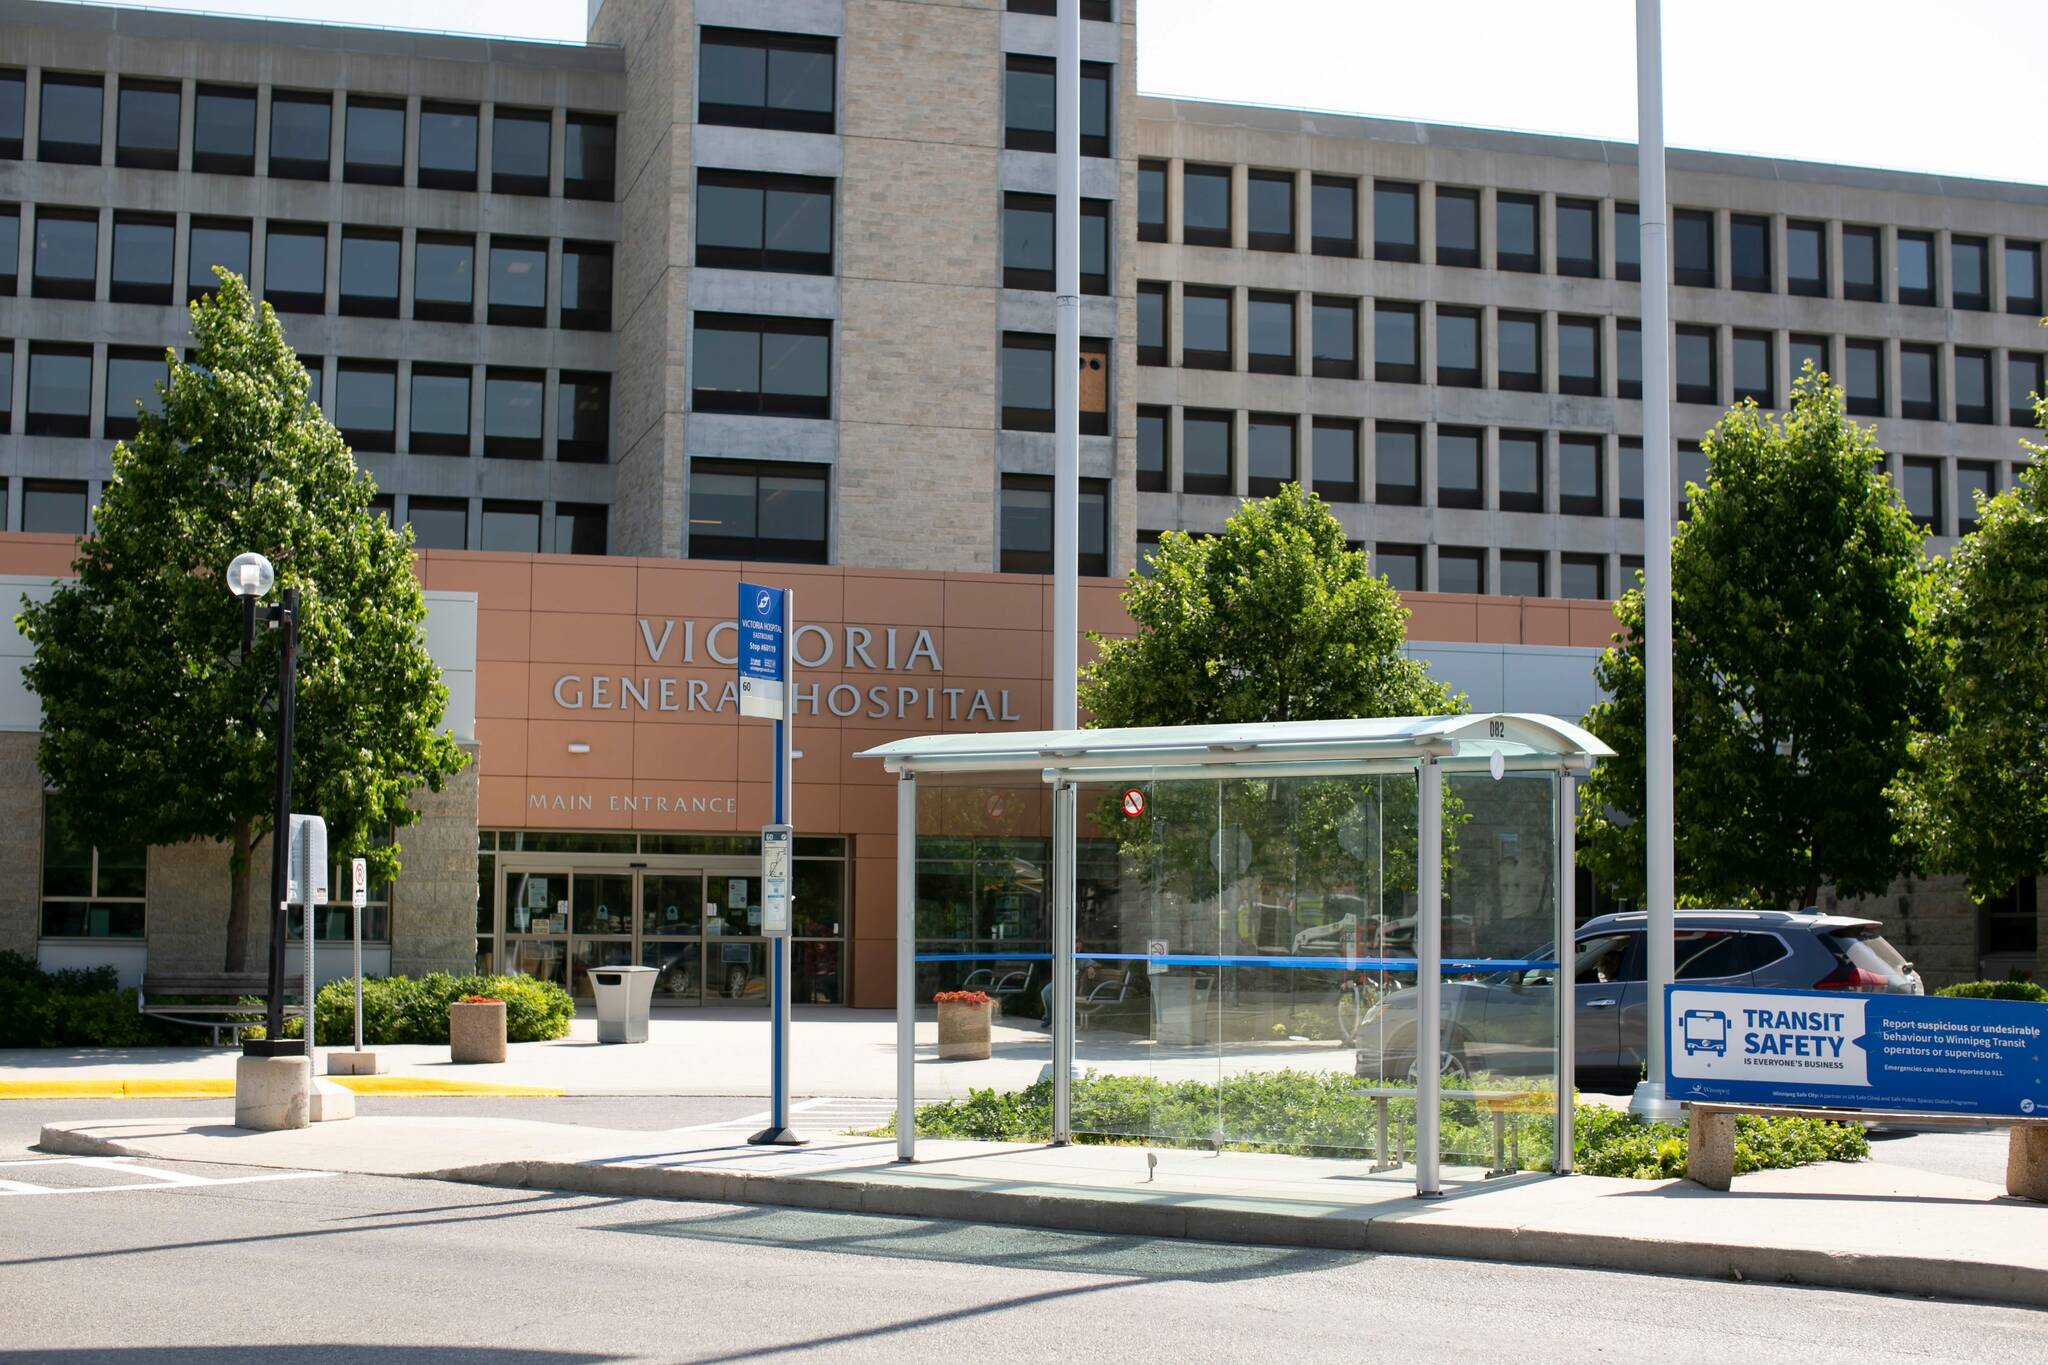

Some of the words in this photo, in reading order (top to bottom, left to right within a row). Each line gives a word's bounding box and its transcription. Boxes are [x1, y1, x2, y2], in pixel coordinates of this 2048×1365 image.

[742, 619, 763, 630] VICTORIA
[764, 622, 783, 633] HOSPITAL
[639, 618, 943, 672] VICORIA
[749, 641, 761, 653] Stop
[742, 681, 751, 692] 60
[553, 674, 738, 712] GENERA
[792, 682, 1020, 722] HOSPITAL
[1489, 720, 1504, 738] 082
[529, 793, 592, 810] MAIN
[609, 795, 737, 813] ENTRANCE
[765, 833, 774, 841] 60
[1743, 1009, 1844, 1032] TRANSIT
[1883, 1019, 1915, 1030] Report
[1917, 1021, 1968, 1032] suspicious
[1970, 1024, 1981, 1032] or
[1982, 1025, 2041, 1036] undesirable
[1744, 1032, 1844, 1058] SAFETY
[1883, 1032, 1932, 1043] behaviour
[1934, 1034, 1944, 1043] to
[1945, 1035, 1991, 1048] Winnipeg
[1992, 1037, 2026, 1048] Transit
[1883, 1046, 1931, 1056] operators
[1944, 1049, 2003, 1060] supervisors.
[1753, 1058, 1803, 1067] EVERYONE'S
[1804, 1061, 1844, 1069] BUSINESS
[1884, 1064, 1922, 1073] Emergencies
[1935, 1066, 1948, 1074] also
[1957, 1068, 1983, 1076] reported
[1772, 1091, 1796, 1099] Winnipeg
